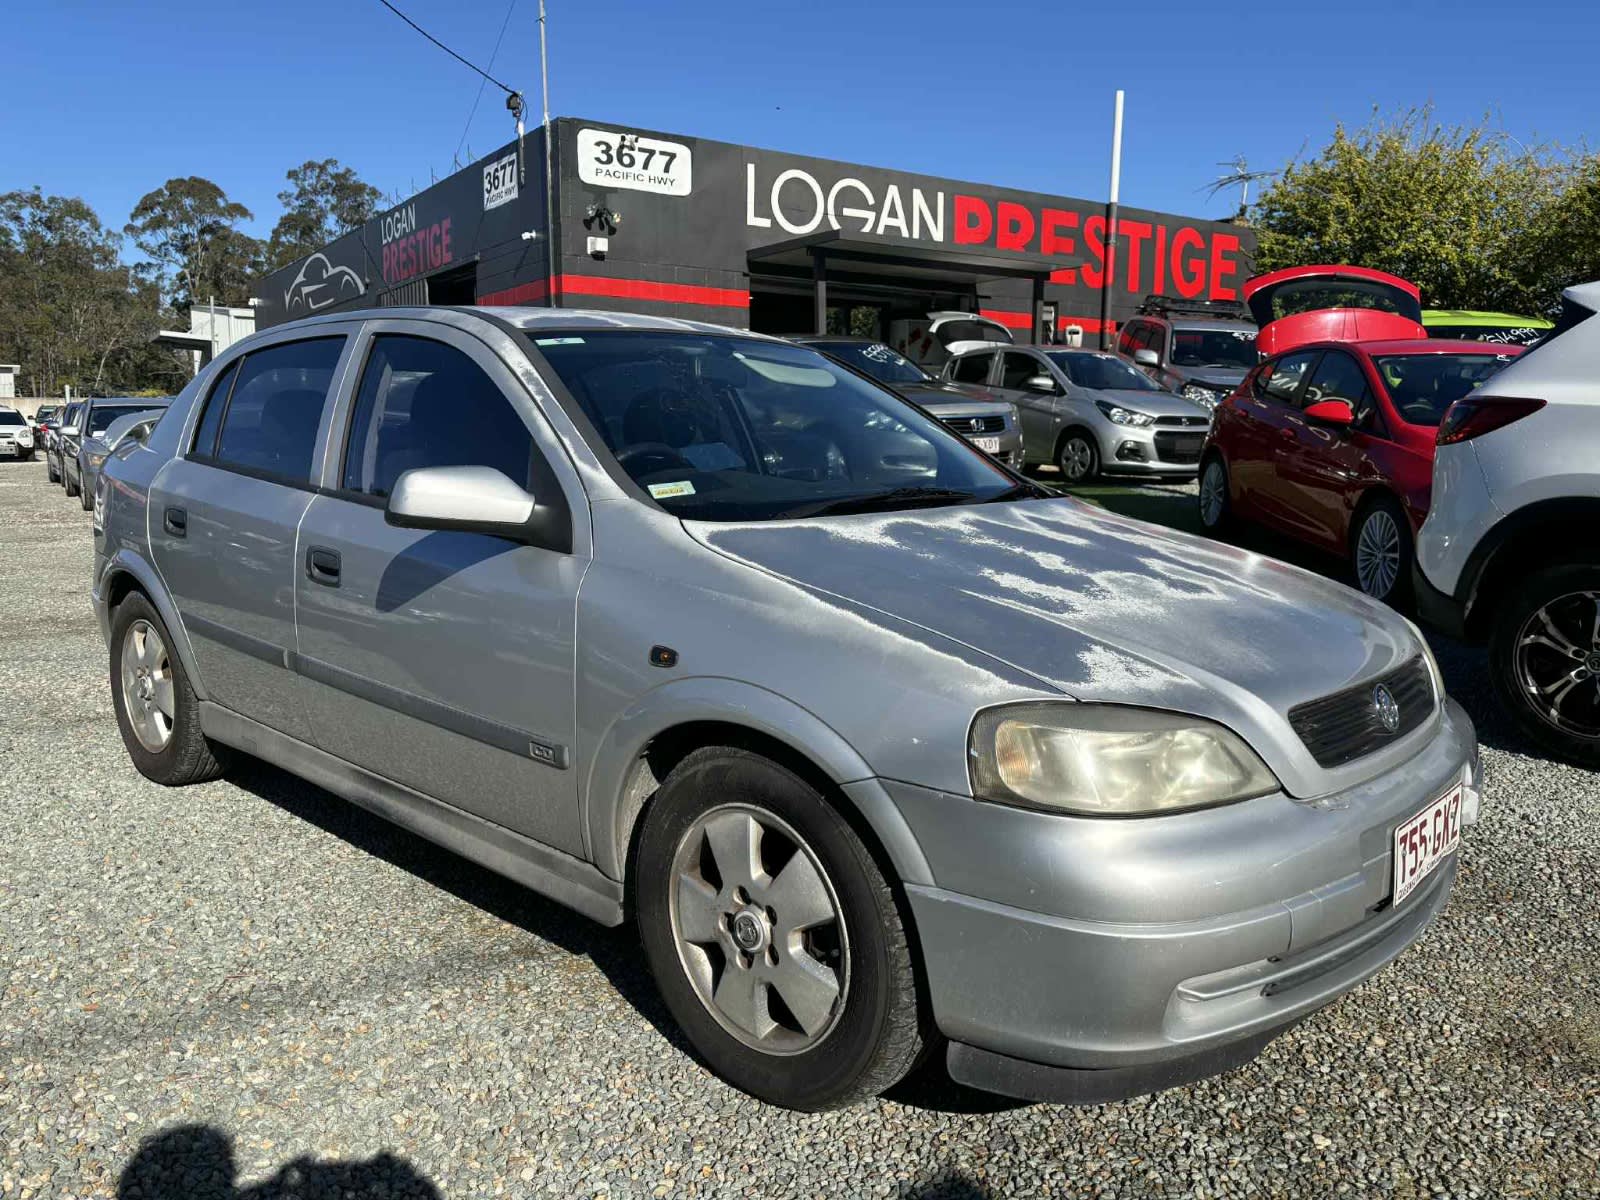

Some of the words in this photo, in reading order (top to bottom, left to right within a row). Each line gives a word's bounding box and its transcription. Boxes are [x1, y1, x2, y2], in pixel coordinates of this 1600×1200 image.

[593, 140, 677, 173] 3677
[485, 159, 515, 194] 3677
[595, 168, 644, 182] PACIFIC
[648, 175, 676, 186] HWY
[380, 203, 416, 245] LOGAN
[747, 163, 944, 242] LOGAN
[953, 194, 1240, 301] PRESTIGE
[383, 216, 452, 284] PRESTIGE
